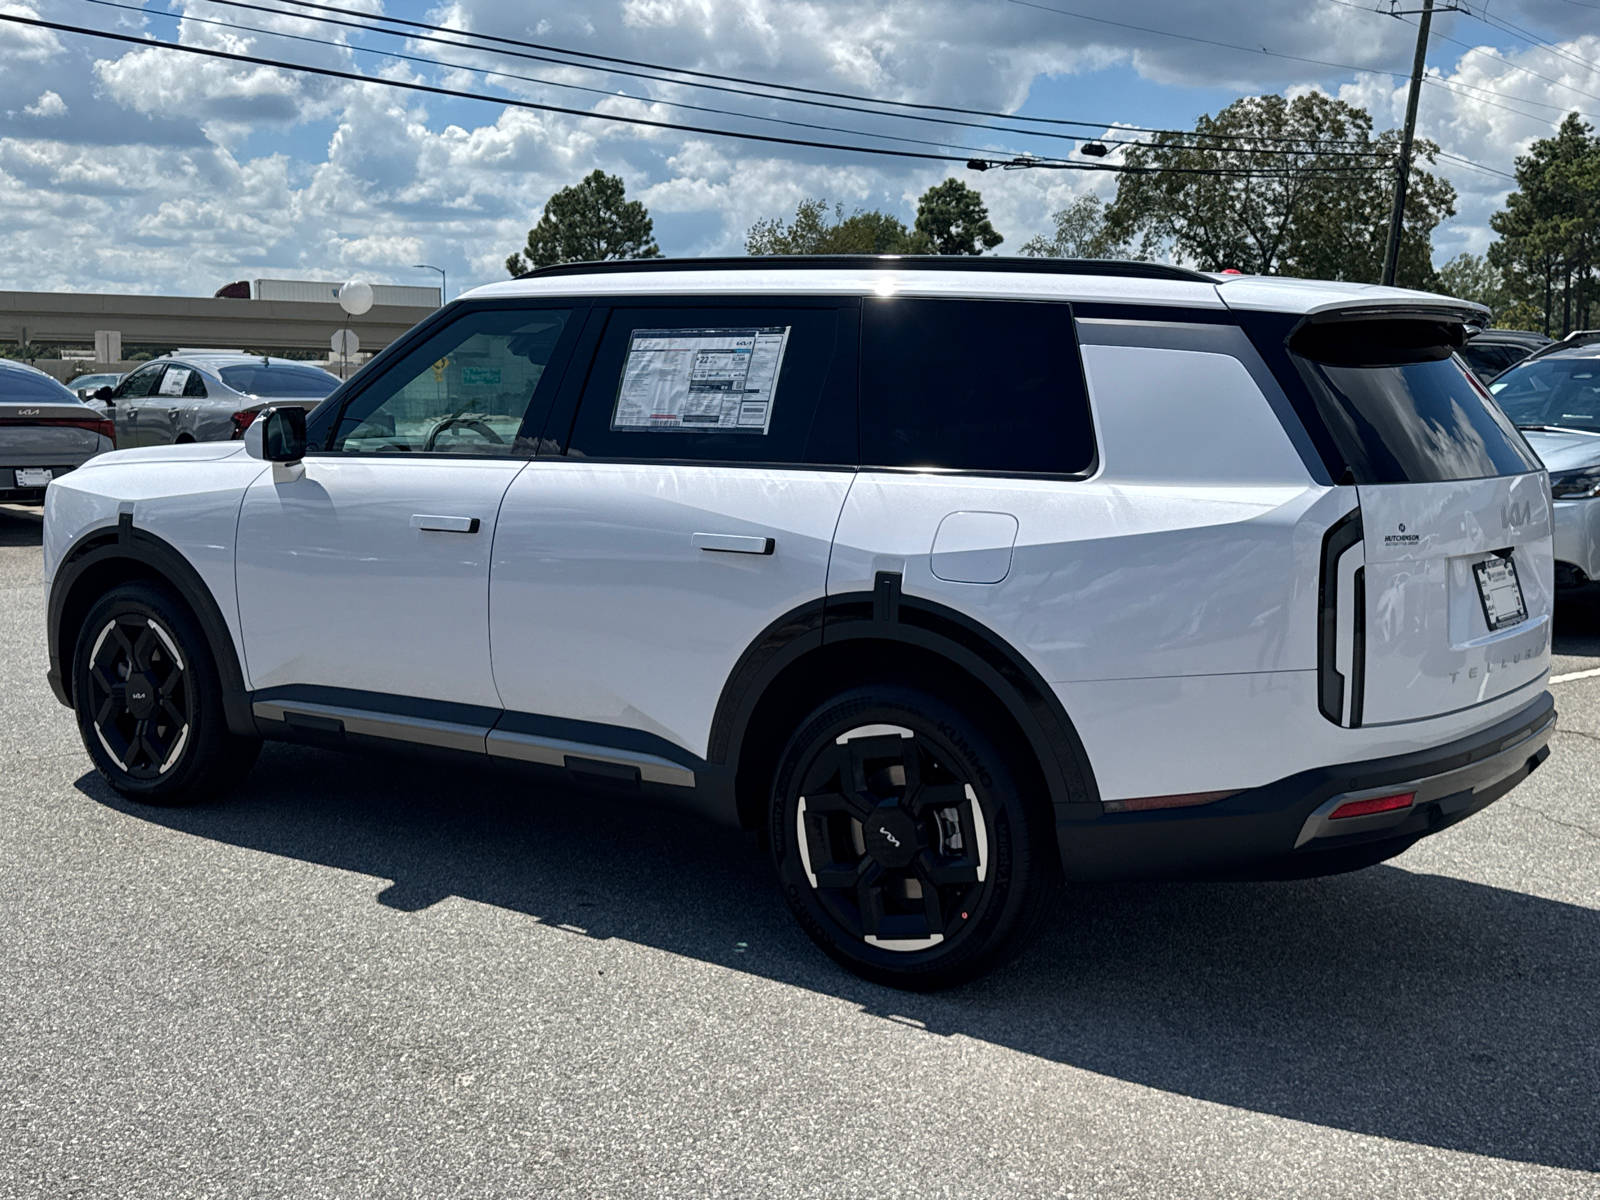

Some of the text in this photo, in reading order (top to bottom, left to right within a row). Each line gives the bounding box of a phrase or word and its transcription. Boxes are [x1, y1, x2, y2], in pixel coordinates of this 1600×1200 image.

[700, 356, 709, 364] 22
[1500, 500, 1531, 530] KIA
[1384, 534, 1420, 542] HUTCHINSON
[132, 692, 146, 700] KIA
[937, 720, 993, 789] KUMHO
[879, 826, 901, 848] KIA
